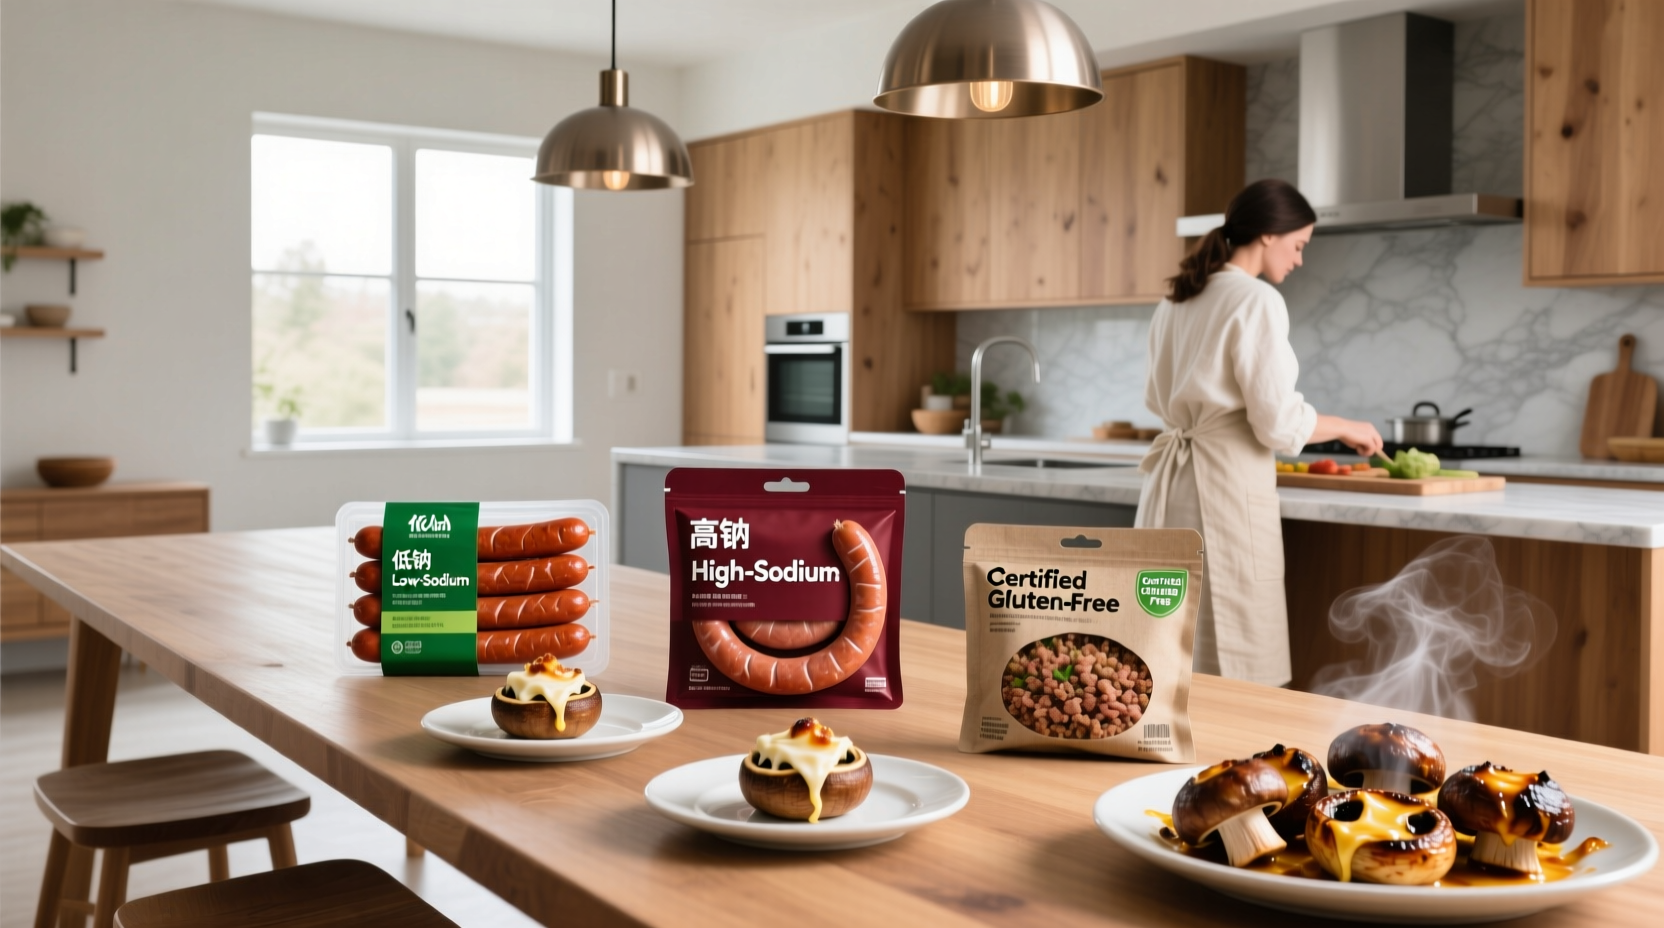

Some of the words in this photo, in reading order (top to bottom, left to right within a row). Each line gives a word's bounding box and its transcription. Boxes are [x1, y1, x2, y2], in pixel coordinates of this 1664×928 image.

[690, 517, 750, 549] 高钠
[691, 559, 840, 589] High-Sodium
[986, 567, 1087, 590] Certified
[987, 589, 1120, 613] Gluten-Free
